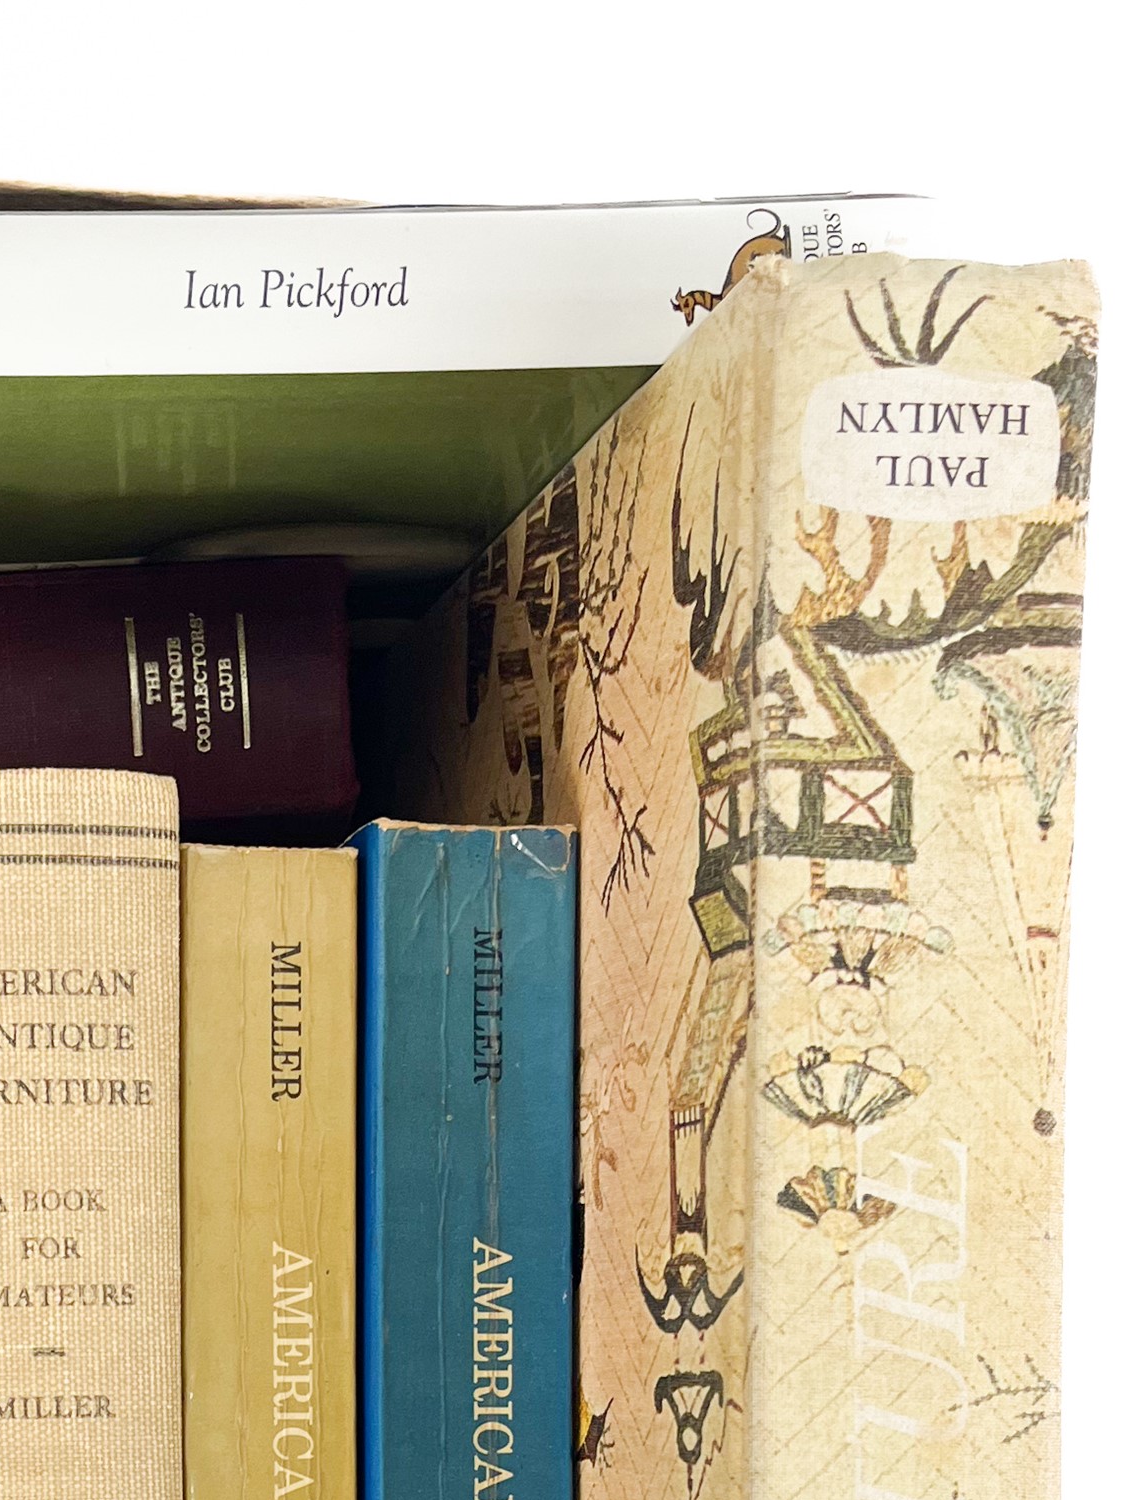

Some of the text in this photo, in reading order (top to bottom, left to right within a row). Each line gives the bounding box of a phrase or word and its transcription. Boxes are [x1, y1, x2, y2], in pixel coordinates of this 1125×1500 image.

[184, 267, 409, 319] Ian Pickford
[837, 402, 1030, 436] HAMLYN
[876, 456, 989, 488] PAUL
[145, 661, 162, 705] THE
[167, 636, 187, 732] ANTIQUE
[219, 657, 235, 712] CLUB
[271, 941, 301, 1102] MILLER
[473, 927, 503, 1085] MILLER
[22, 1189, 107, 1213] BOOK
[21, 1237, 81, 1260] FOR
